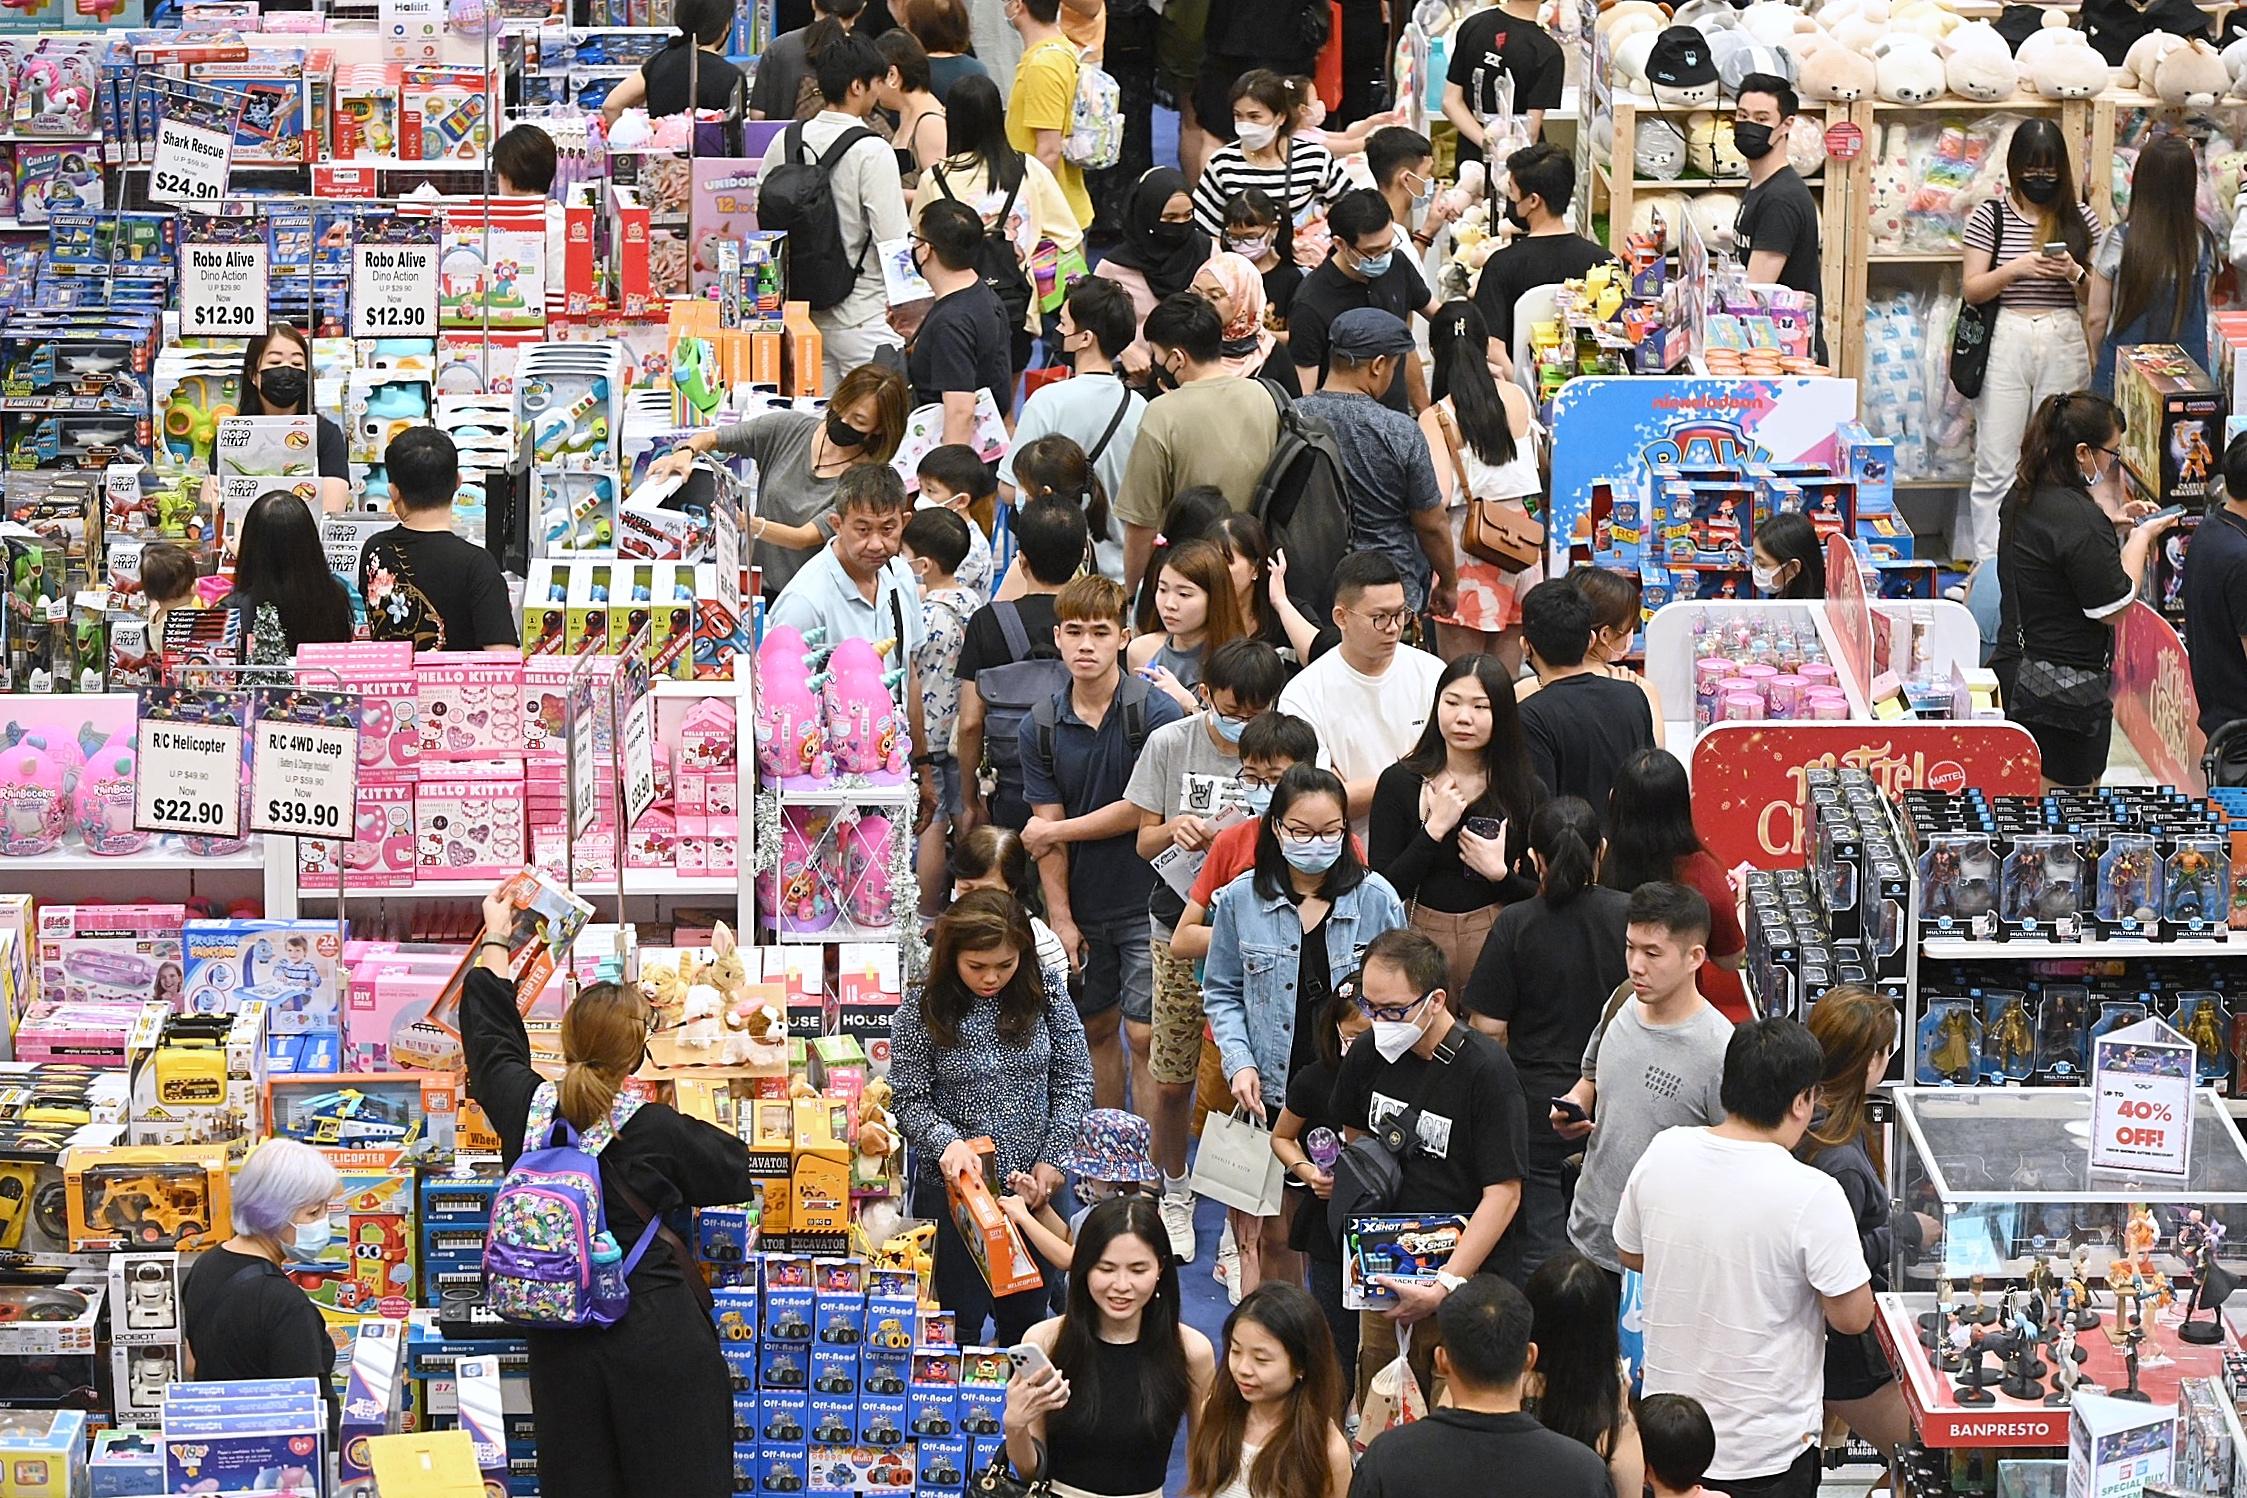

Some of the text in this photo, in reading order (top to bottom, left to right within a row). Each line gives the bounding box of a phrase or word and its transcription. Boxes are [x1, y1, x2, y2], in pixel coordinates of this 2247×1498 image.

[163, 131, 224, 159] Shark Rescue
[27, 153, 57, 167] Glitter
[156, 171, 218, 198] $24.90
[716, 196, 736, 214] 12
[54, 216, 92, 225] TEAMSTERZ
[193, 251, 254, 267] Robo Alive
[365, 251, 426, 267] Robo Alive
[200, 270, 248, 281] Dino Action
[372, 270, 419, 281] Dino Action
[220, 283, 241, 292] $29.90
[392, 284, 412, 293] $29.90
[216, 294, 231, 303] Now
[387, 295, 402, 304] Now
[195, 306, 254, 325] $12.90
[366, 307, 425, 326] $12.90
[5, 398, 46, 408] TEAMSTERZ
[1651, 393, 1764, 410] nickelodeon
[222, 429, 251, 439] ROBO
[221, 437, 249, 447] ALIVE
[1639, 435, 1774, 473] PAW
[111, 477, 135, 485] ROBO
[229, 480, 257, 489] ROBO
[228, 487, 256, 497] ALIVE
[624, 510, 652, 528] SPEED
[328, 526, 357, 535] ROBO
[621, 518, 663, 543] MACHINA
[1616, 528, 1635, 539] RC
[1670, 526, 1689, 537] RC
[113, 554, 138, 563] ROBO
[328, 554, 356, 564] ROBO
[112, 561, 137, 569] ALIVE
[116, 631, 140, 640] ROBO
[117, 638, 139, 646] ALIVE
[651, 657, 666, 672] RULE
[417, 671, 515, 683] HELLO KITTY
[525, 674, 567, 684] HELLO
[361, 683, 412, 695] KITTY
[153, 733, 226, 756] R/C Helicopter
[269, 733, 342, 759] R/C 4WD Jeep
[184, 771, 209, 781] $49.90
[299, 776, 324, 787] $59.90
[1929, 771, 1965, 788] MATTEL
[179, 786, 197, 796] Now
[294, 788, 312, 799] Now
[358, 787, 407, 800] KITTY
[418, 785, 516, 797] HELLO KITTY
[153, 797, 223, 825] $22.90
[268, 799, 340, 828] $39.90
[1939, 918, 1954, 928] DC
[2022, 918, 2037, 929] DC
[2121, 918, 2136, 929] DC
[2188, 918, 2203, 929] DC
[321, 936, 336, 946] 24
[46, 949, 57, 957] 15
[353, 992, 371, 1001] DIY
[788, 1016, 820, 1028] USE
[843, 1013, 894, 1027] HOUSE
[2056, 1062, 2071, 1073] DC
[1647, 1064, 1684, 1085] WONDER.
[1644, 1073, 1682, 1094] WANDER.
[1643, 1081, 1680, 1102] REPEAT.
[2103, 1089, 2112, 1097] UP
[2117, 1100, 2173, 1122] 40%
[470, 1132, 500, 1146] Wheel
[2115, 1127, 2165, 1148] OFF!
[323, 1153, 386, 1164] ELICOPTER
[703, 1218, 743, 1229] Off-Road
[791, 1238, 846, 1250] EXCAVATOR
[1007, 1276, 1041, 1290] HELICOPTER
[714, 1299, 753, 1308] Off-Road
[770, 1297, 812, 1307] Off-Road
[820, 1302, 861, 1311] Off-Road
[871, 1306, 913, 1315] Off-Road
[115, 1332, 157, 1341] ROBOT
[814, 1352, 856, 1361] Off-Road
[865, 1352, 907, 1361] Off-Road
[763, 1399, 804, 1408] Off-Road
[912, 1394, 953, 1403] Off-Road
[961, 1393, 1002, 1403] Off-Road
[812, 1401, 853, 1410] Off-Road
[862, 1402, 903, 1412] Off-Road
[118, 1411, 159, 1419] ROBOT
[1950, 1421, 2050, 1437] BANPRESTO
[294, 1441, 308, 1452] 0+
[922, 1443, 963, 1453] Off-Road
[1847, 1447, 1878, 1457] DRAGON
[762, 1450, 803, 1460] Off-Road
[2101, 1479, 2142, 1497] SPECIAL
[2144, 1472, 2165, 1485] BUY
